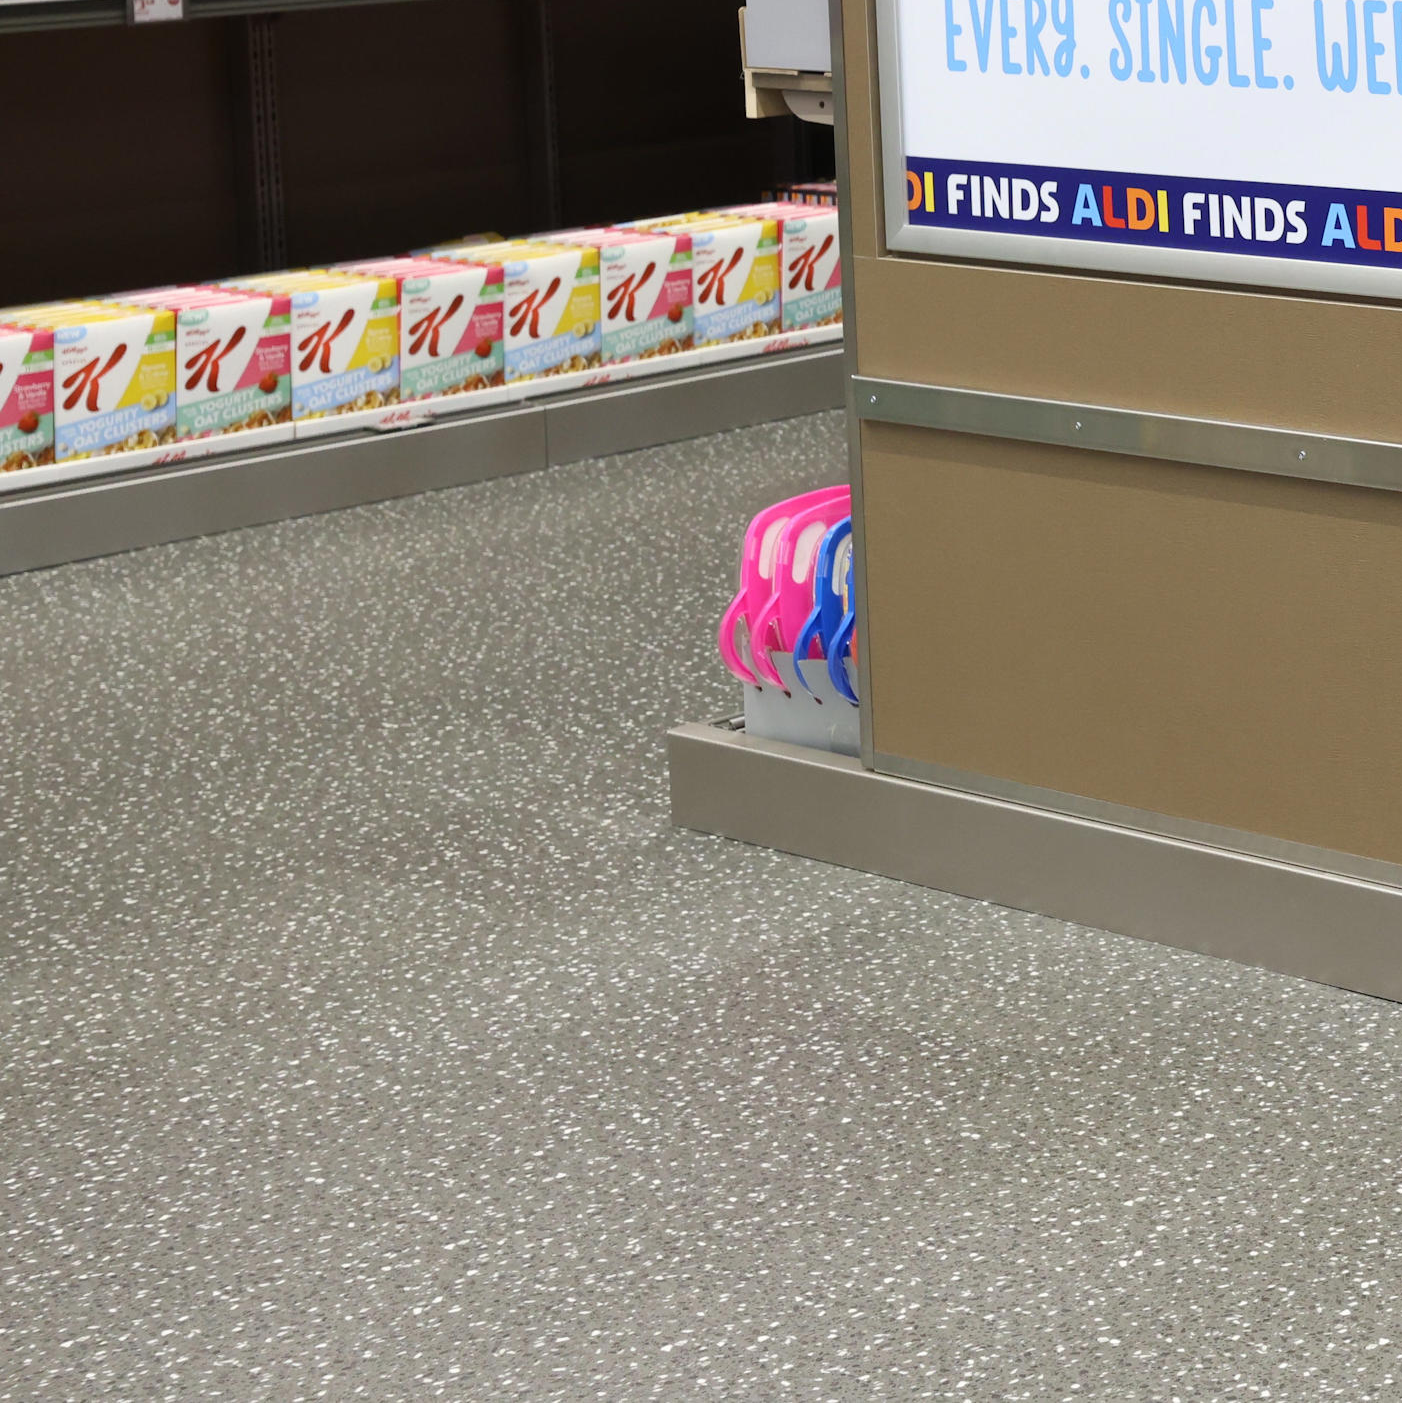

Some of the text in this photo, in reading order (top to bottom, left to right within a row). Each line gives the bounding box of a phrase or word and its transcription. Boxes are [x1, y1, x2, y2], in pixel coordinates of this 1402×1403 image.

[947, 173, 1058, 224] FINDS
[1072, 183, 1169, 233] ALDI
[1183, 194, 1307, 247] FINDS
[409, 294, 463, 357] K
[62, 343, 127, 412] K
[184, 326, 246, 392] K
[417, 357, 496, 392] OAT CLUSTERS
[421, 354, 472, 380] YOGURTY
[194, 392, 283, 429] OAT CLUSTERS
[198, 388, 255, 415] YOGURTY
[74, 412, 168, 449] OAT CLUSTERS
[78, 407, 139, 434] YOGURTY
